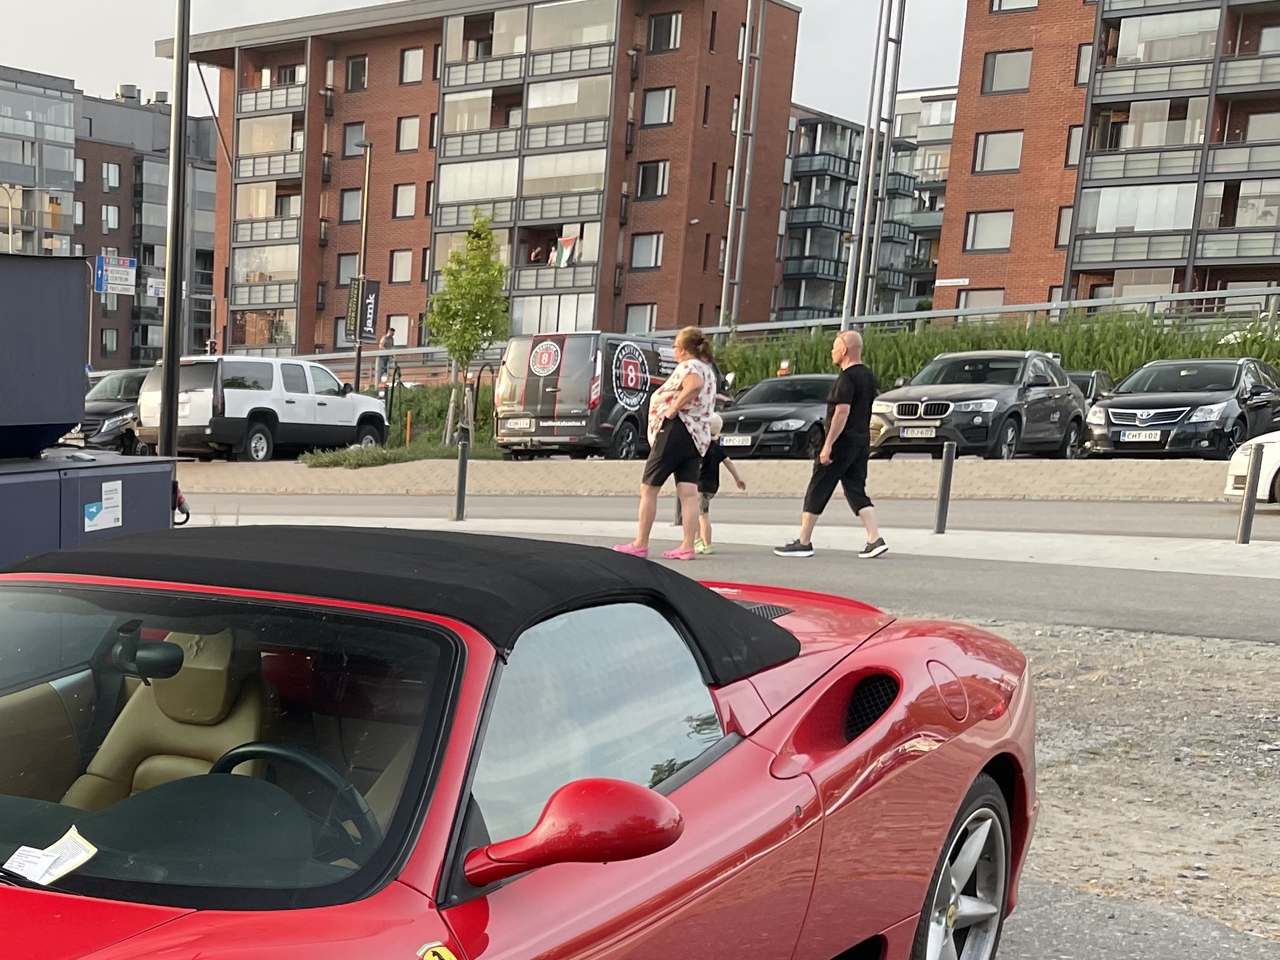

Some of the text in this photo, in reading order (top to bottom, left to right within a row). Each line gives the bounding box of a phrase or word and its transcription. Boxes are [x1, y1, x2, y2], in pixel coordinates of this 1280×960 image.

[363, 293, 376, 333] jamk
[541, 353, 549, 365] 8
[627, 365, 636, 387] 8
[1126, 432, 1159, 440] CHT-102
